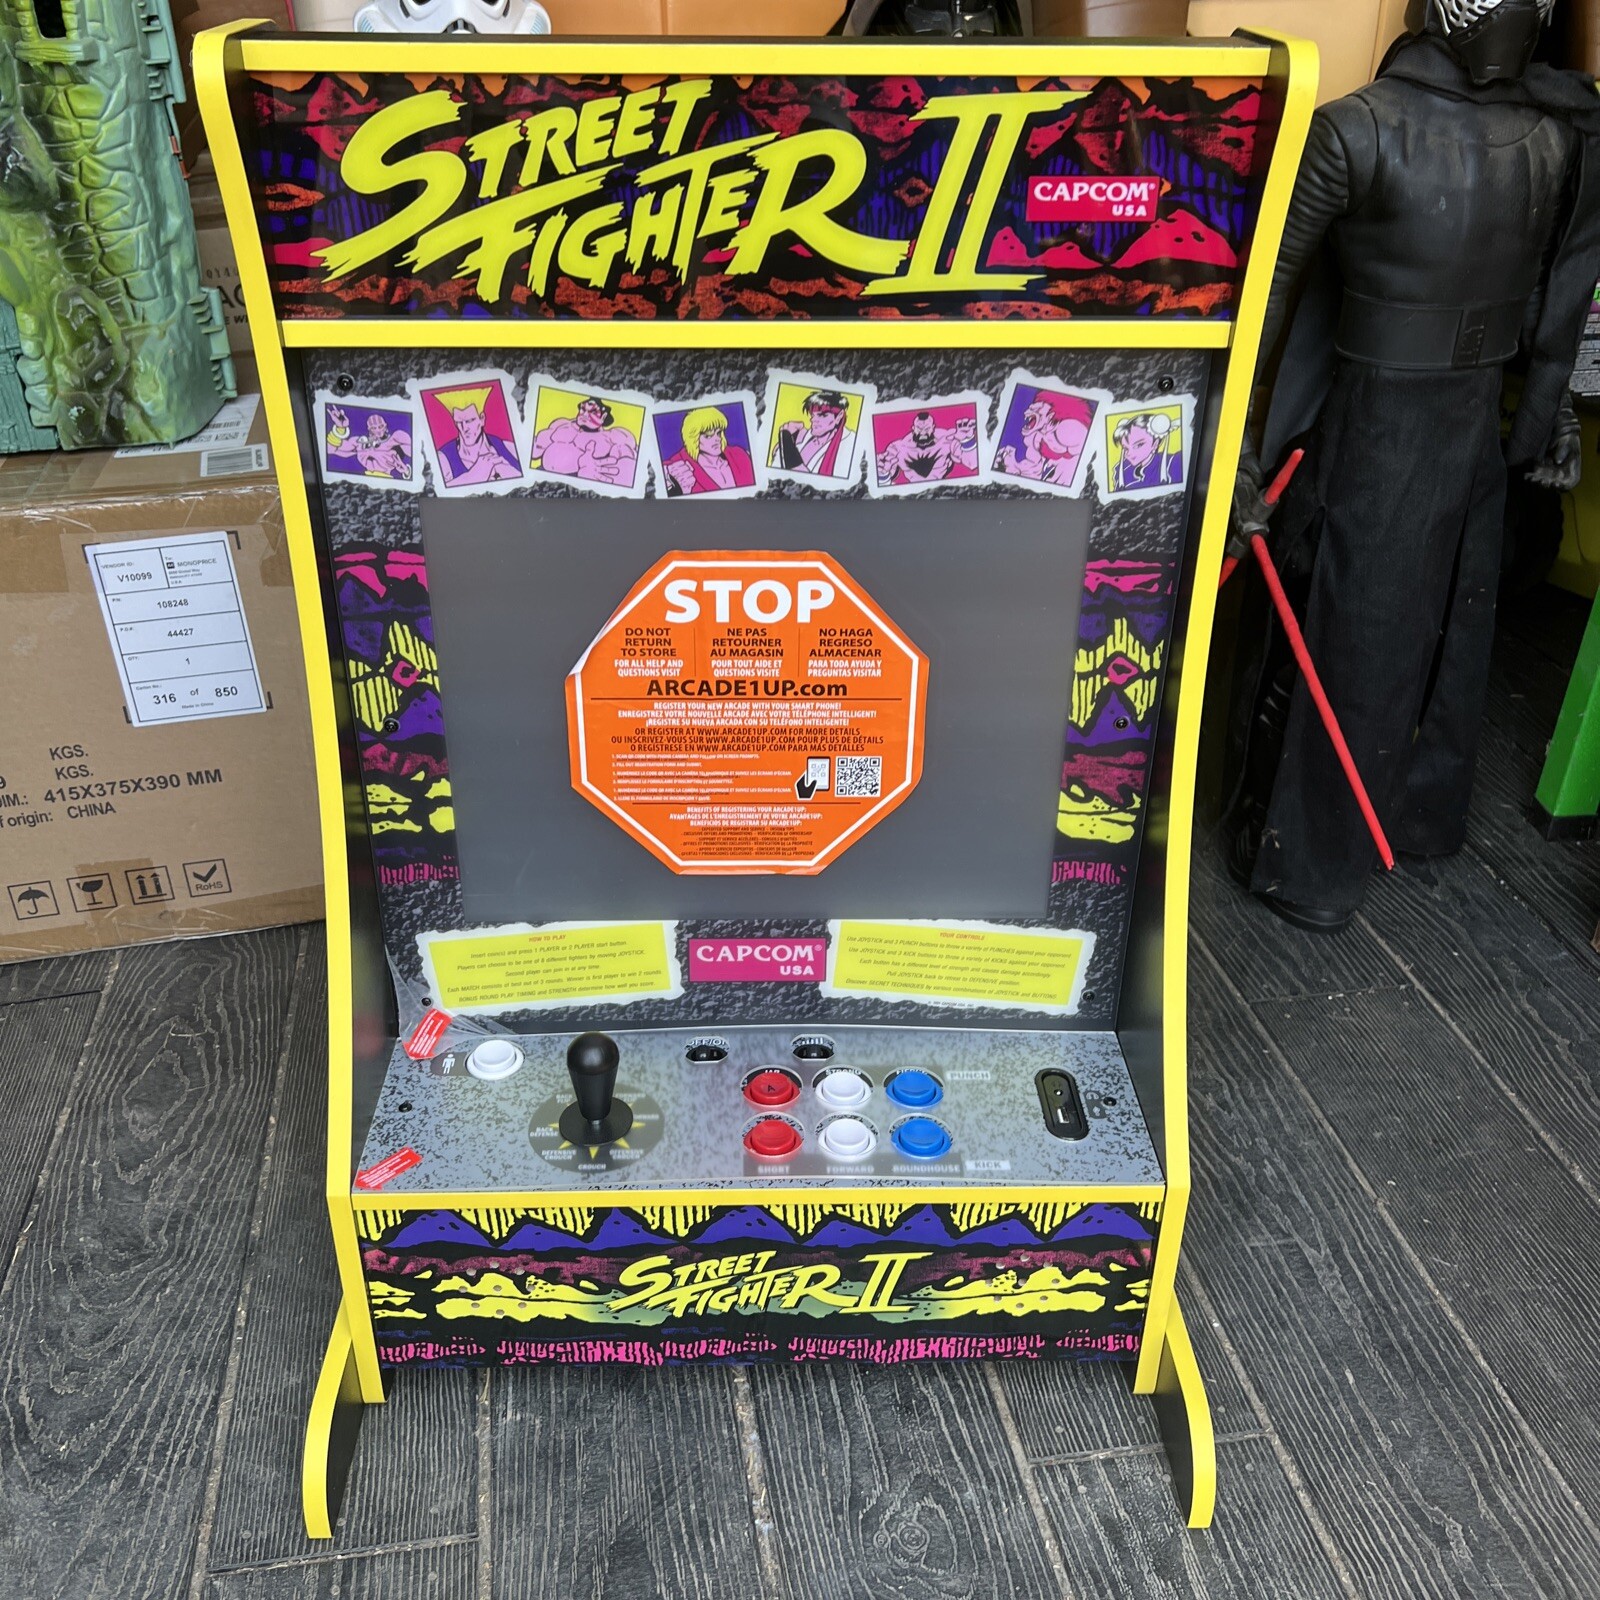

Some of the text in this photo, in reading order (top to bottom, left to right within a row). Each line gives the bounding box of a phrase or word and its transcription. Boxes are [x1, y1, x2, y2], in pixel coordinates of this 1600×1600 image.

[310, 79, 712, 284] STREET
[860, 89, 1093, 296] II
[1112, 204, 1148, 216] USA
[395, 129, 909, 304] FIGHTER
[117, 572, 152, 582] V10099
[157, 598, 189, 609] 108248
[664, 579, 835, 623] STOP
[167, 628, 194, 638] 44427
[625, 628, 671, 636] DO NOT
[727, 628, 767, 636] NE PAS
[819, 628, 873, 637] NO HAGA
[625, 638, 671, 646] RETURN
[712, 638, 781, 647] RETOURNER
[820, 638, 872, 647] REGRESO
[621, 648, 676, 656] TO STORE
[710, 648, 784, 657] AU MAGASIN
[809, 648, 881, 657] ALMACENAR
[614, 659, 683, 668] FOR ALL HELP AND
[712, 659, 782, 668] POUR TOUT AIDE ET
[808, 659, 882, 668] PARA TODA AYUDA Y
[618, 668, 680, 677] QUESTIONS VISIT
[714, 668, 779, 677] QUESTIONS VISITE
[808, 668, 882, 677] PREGUNTAS VISITAR
[647, 680, 847, 696] ARCADE1UP.com
[153, 686, 238, 704] 316 of 850
[654, 702, 686, 710] REGISTER
[685, 702, 707, 710] YOUR
[706, 702, 724, 710] NEW
[723, 702, 750, 710] ARCADE
[750, 702, 770, 710] WITH
[769, 702, 790, 710] YOUR
[791, 702, 815, 710] SMART
[618, 710, 663, 718] ENREGISTREZ
[664, 710, 686, 718] VOTRE
[686, 710, 721, 718] NOUVELLE
[721, 710, 749, 718] ARCADE
[749, 710, 767, 718] AVEC
[768, 710, 790, 718] VOTRE
[681, 718, 691, 726] SU
[691, 718, 714, 726] NUEVA
[715, 718, 742, 726] ARCADA
[743, 718, 758, 726] CON
[759, 718, 768, 726] SU
[50, 745, 88, 760] KGS.
[631, 744, 636, 752] O
[684, 744, 694, 752] EN
[696, 744, 786, 752] WWW.ARCADE1UP.COM
[786, 744, 808, 752] PARA
[826, 744, 864, 752] DETALLES
[55, 765, 94, 780] KGS.
[44, 774, 180, 803] 415X375X390
[187, 769, 223, 786] MM
[8, 802, 116, 827] origin: CHINA
[195, 881, 223, 891] RoHS
[780, 965, 814, 976] USA
[758, 1166, 790, 1174] SHORT
[826, 1165, 874, 1174] FORWARD
[892, 1164, 961, 1173] ROUNDHOUSE
[604, 1250, 777, 1312] STREET
[839, 1252, 934, 1314] II
[642, 1264, 859, 1318] FIGHTER
